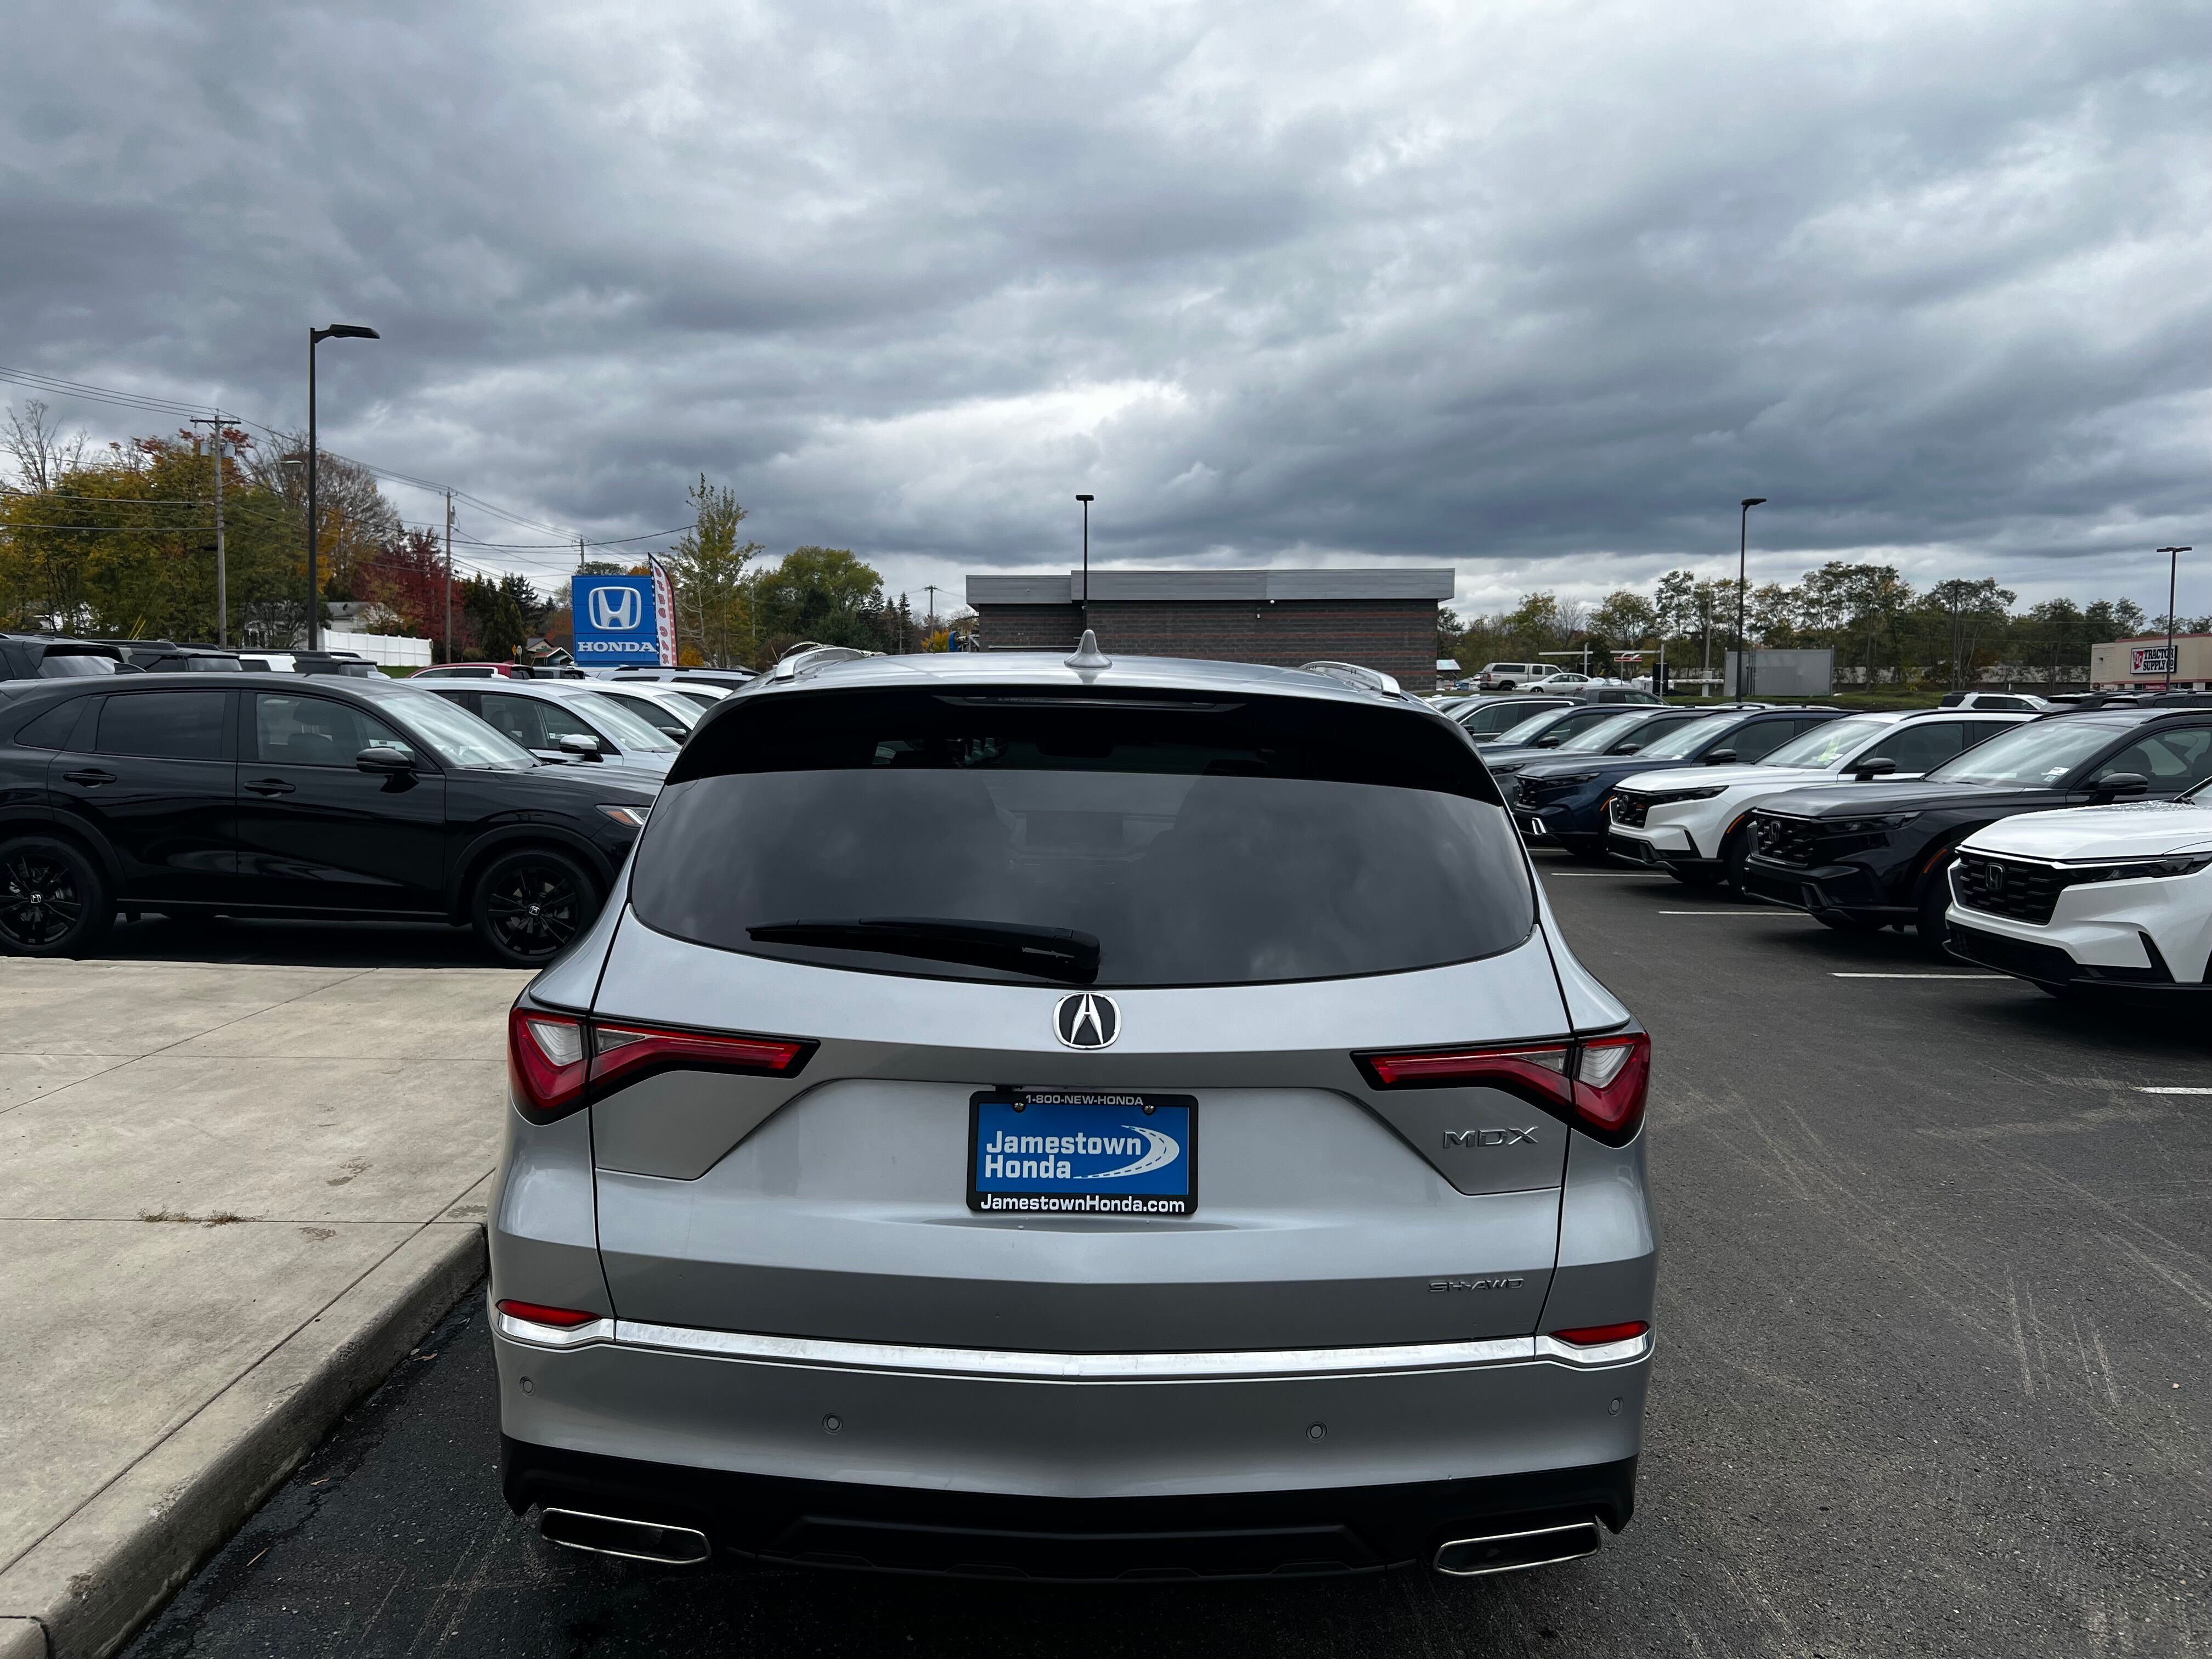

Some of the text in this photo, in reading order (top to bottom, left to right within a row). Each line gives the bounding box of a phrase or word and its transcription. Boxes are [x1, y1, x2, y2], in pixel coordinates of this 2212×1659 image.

[578, 642, 657, 652] HONDA
[2134, 652, 2142, 667] TSC
[2143, 660, 2166, 670] SUPPLY
[1026, 1094, 1143, 1106] 1-800-NEW-HONDA
[986, 1131, 1141, 1155] Jamestown
[1443, 1126, 1539, 1149] MDX
[985, 1155, 1071, 1179] Honda
[981, 1194, 1184, 1212] JamestownHonda.com
[1429, 1278, 1525, 1293] SH-AWD
